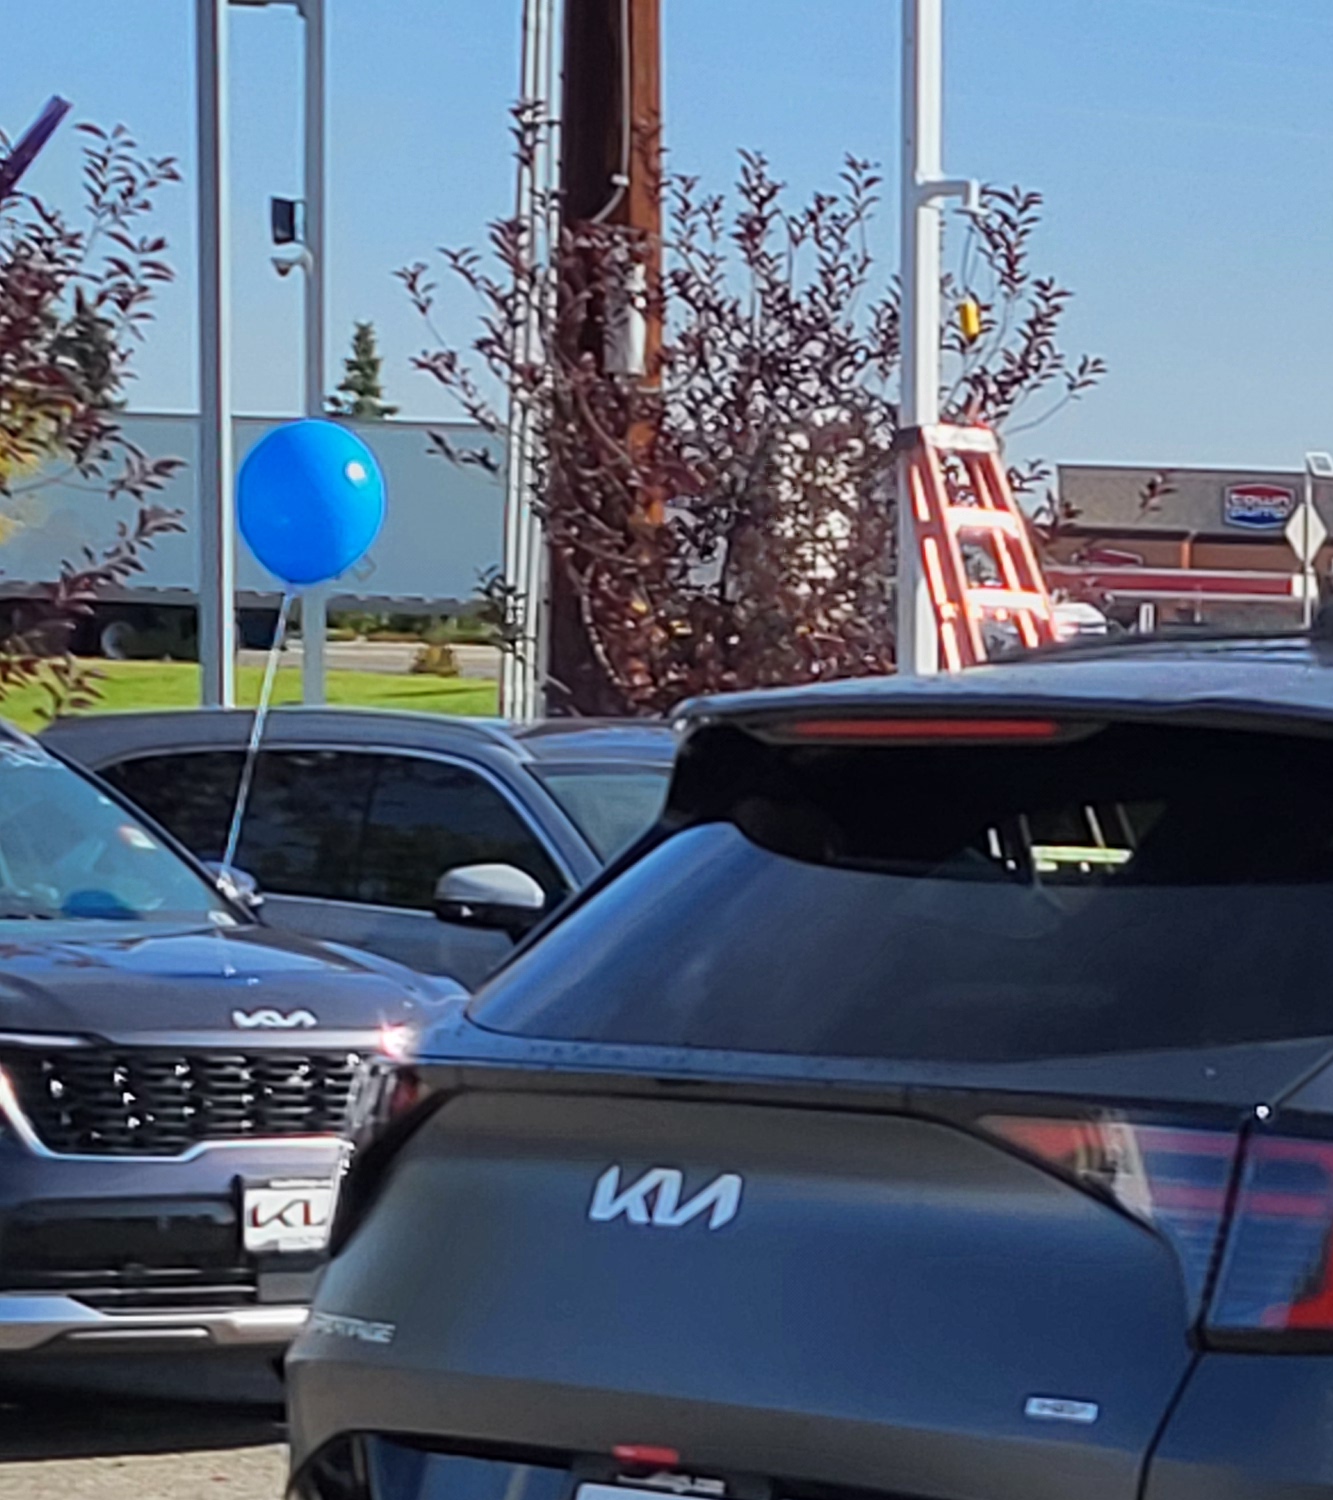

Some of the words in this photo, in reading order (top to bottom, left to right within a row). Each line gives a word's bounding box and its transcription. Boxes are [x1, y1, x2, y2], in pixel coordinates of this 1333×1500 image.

[232, 1009, 318, 1028] KIA
[589, 1165, 742, 1230] KIA
[248, 1199, 327, 1228] KI
